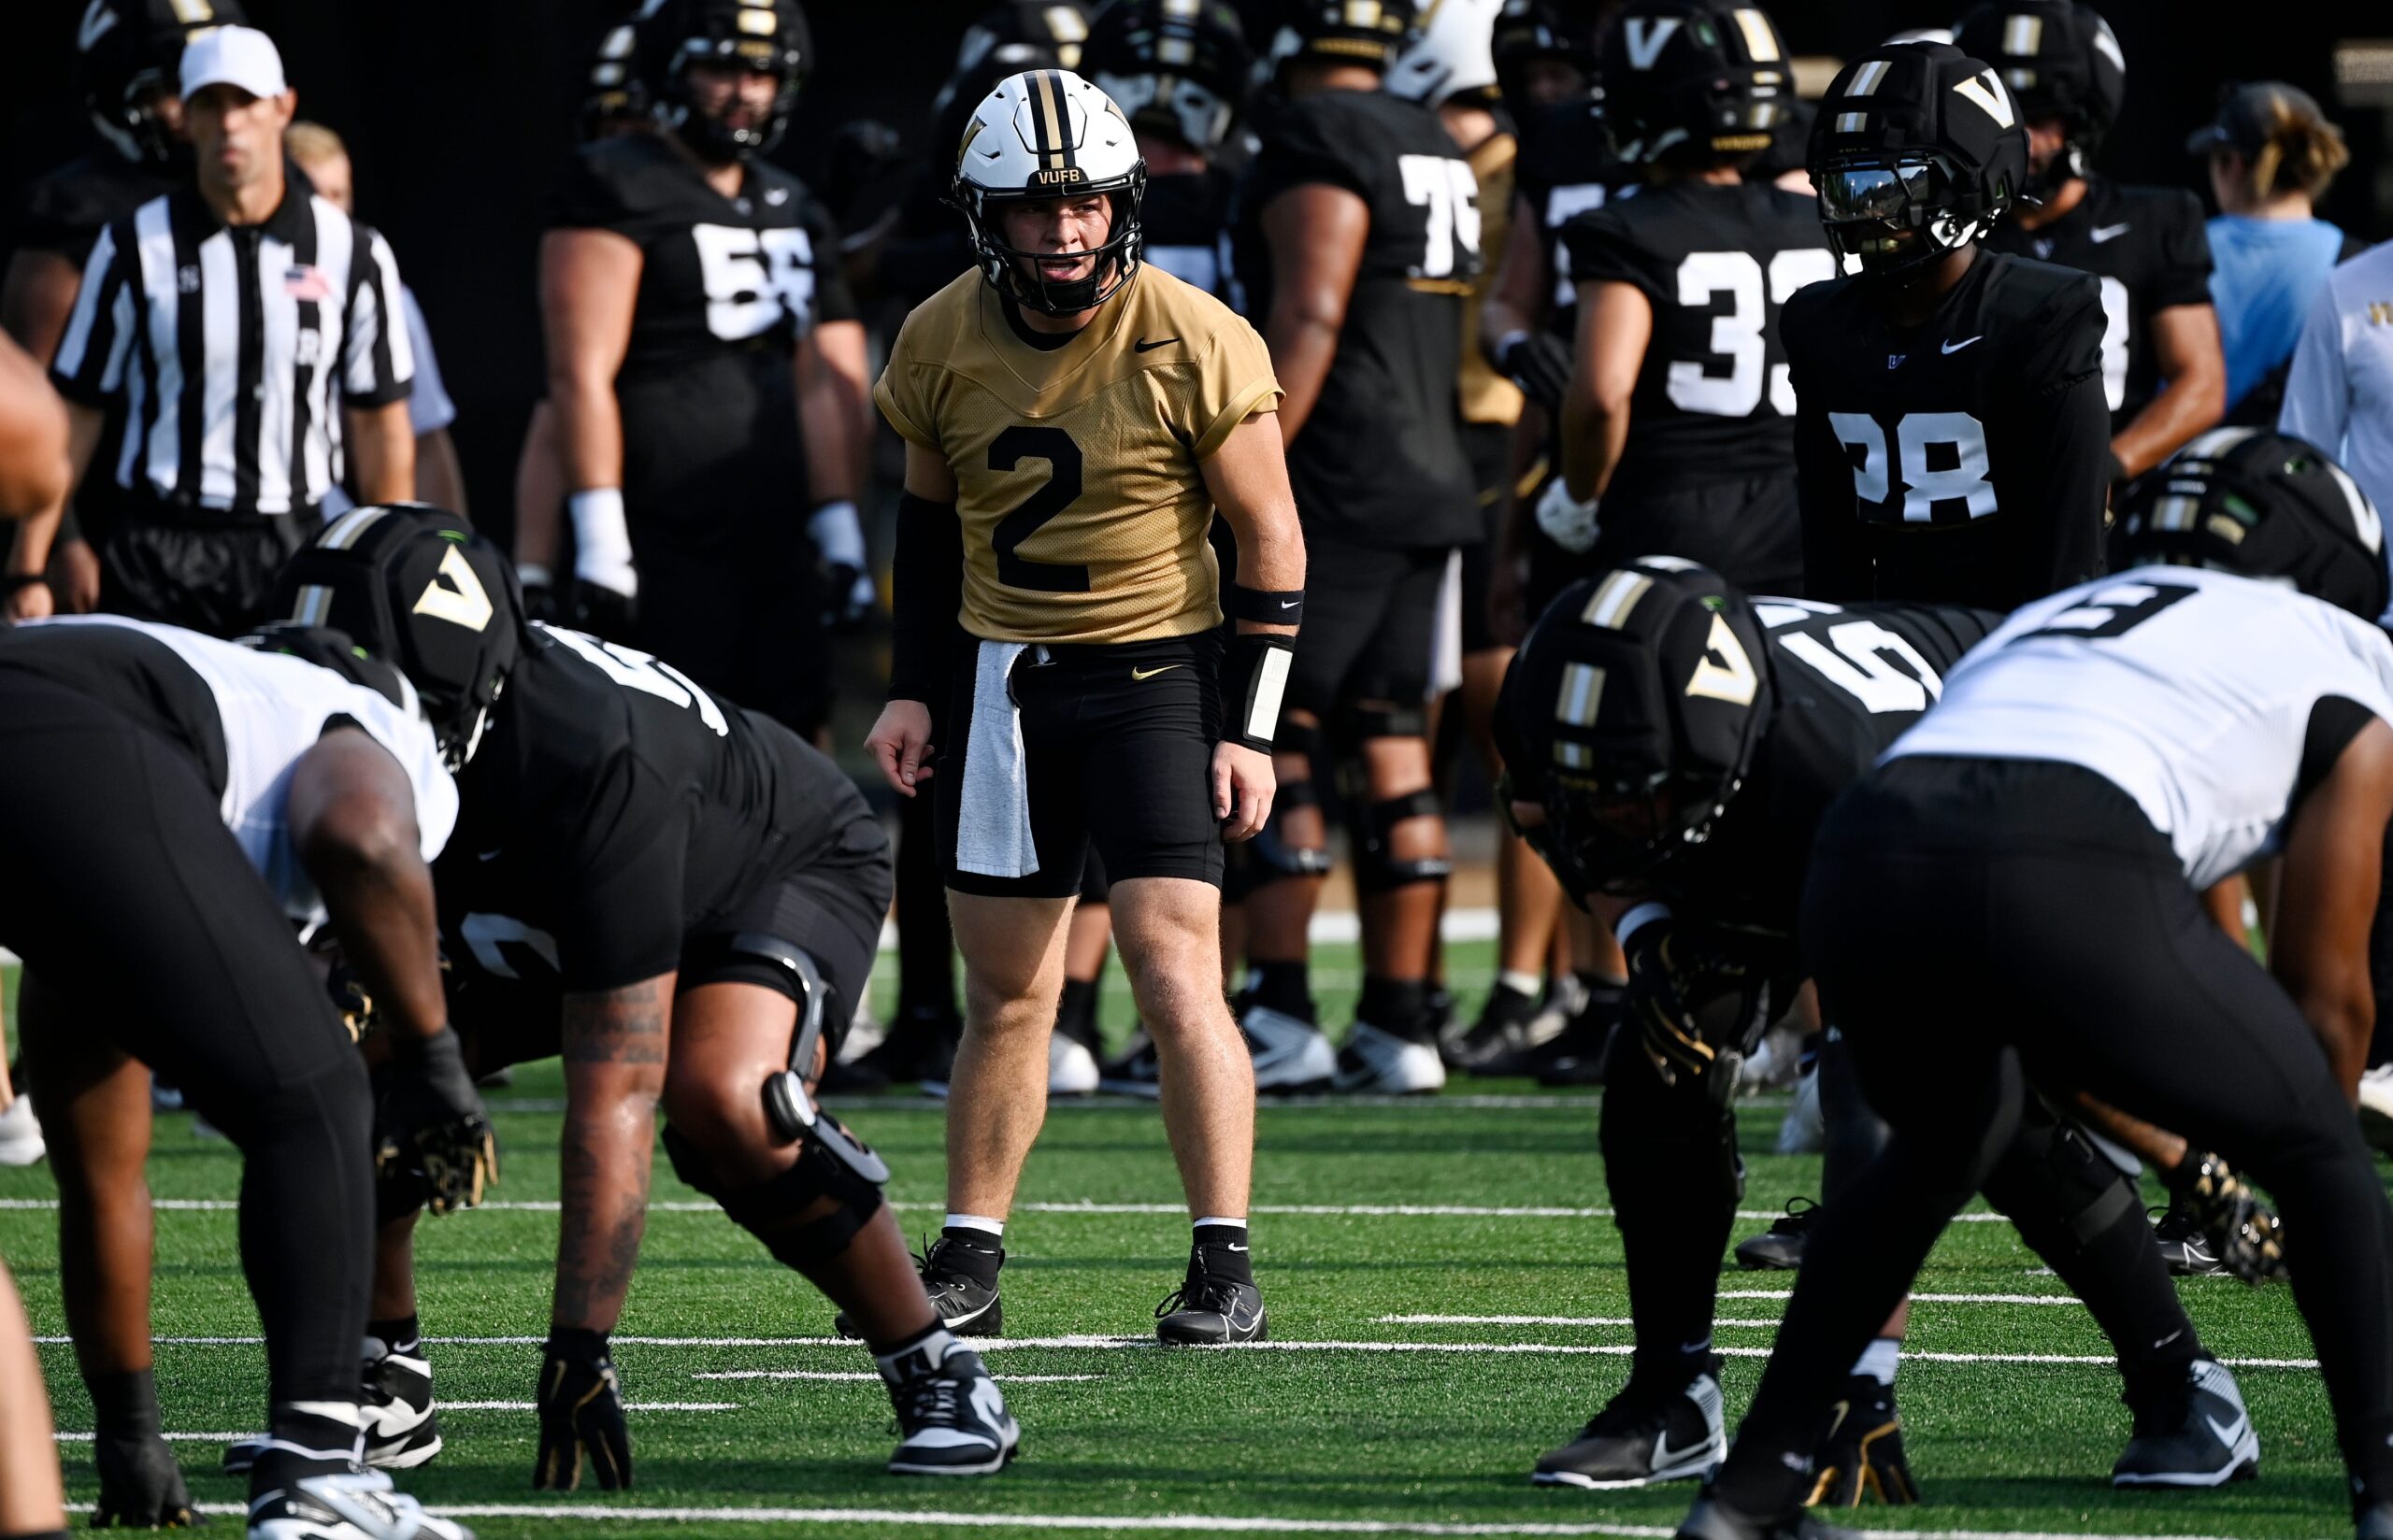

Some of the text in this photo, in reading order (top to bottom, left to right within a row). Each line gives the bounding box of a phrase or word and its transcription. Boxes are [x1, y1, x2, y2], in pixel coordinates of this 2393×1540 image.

[1625, 17, 1683, 70] V
[1952, 67, 2015, 129] V
[1038, 169, 1080, 185] VUFB
[1888, 354, 1907, 369] V
[987, 425, 1091, 592] 2
[411, 542, 494, 633] V
[1684, 611, 1758, 706] V
